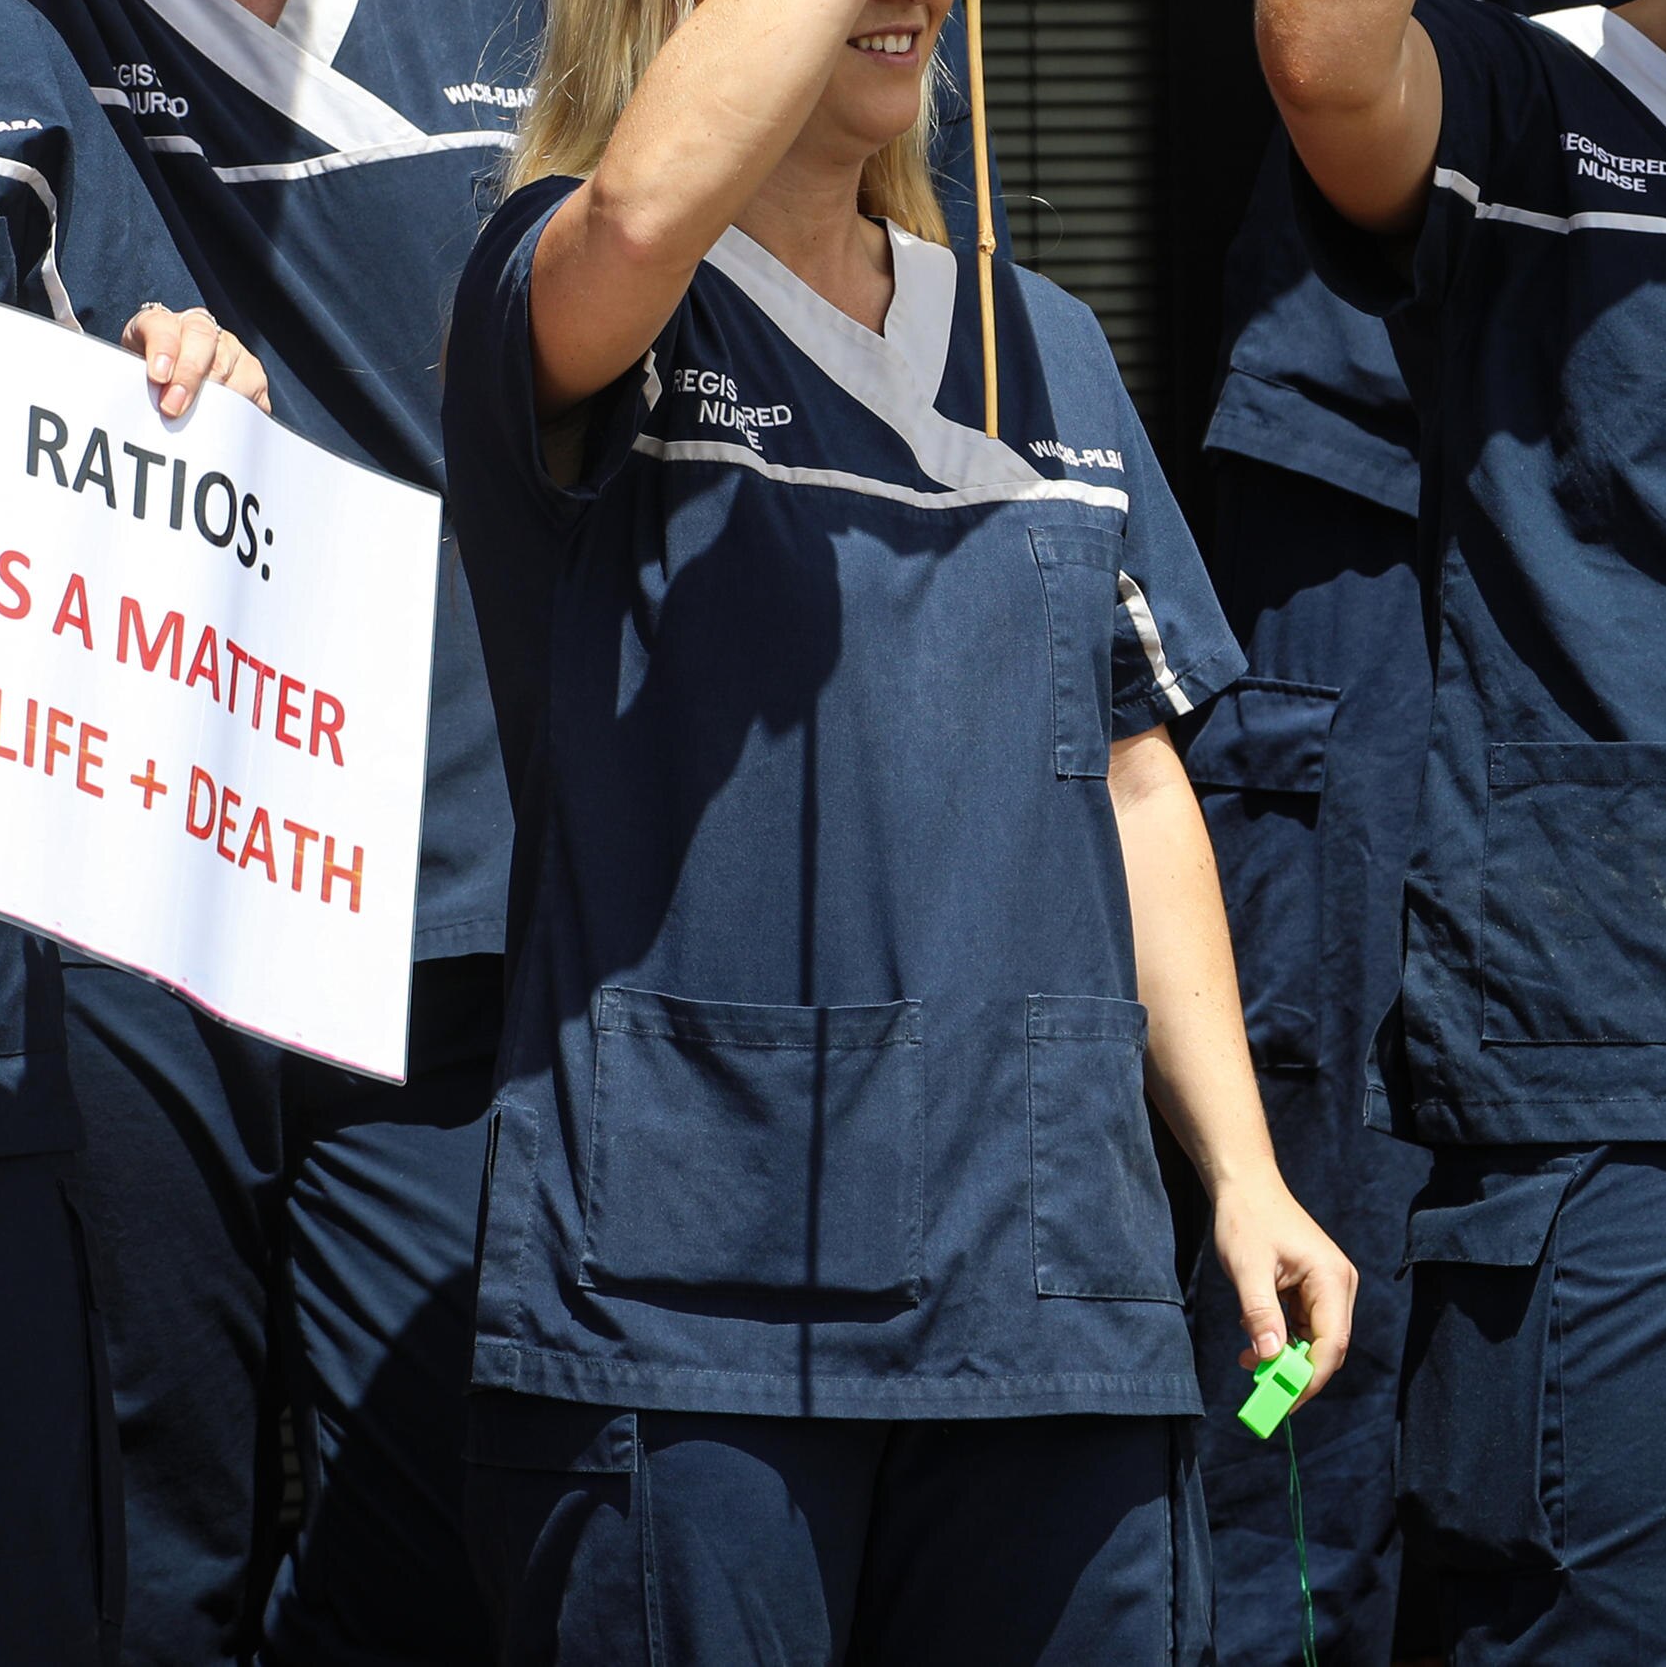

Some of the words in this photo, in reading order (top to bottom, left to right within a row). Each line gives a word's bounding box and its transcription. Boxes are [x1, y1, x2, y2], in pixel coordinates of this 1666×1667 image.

[1577, 157, 1648, 193] NURSE
[25, 403, 274, 582] RATIOS:
[52, 573, 94, 651] A
[116, 595, 348, 767] MATTER
[130, 758, 168, 812] +
[185, 764, 366, 915] DEATH
